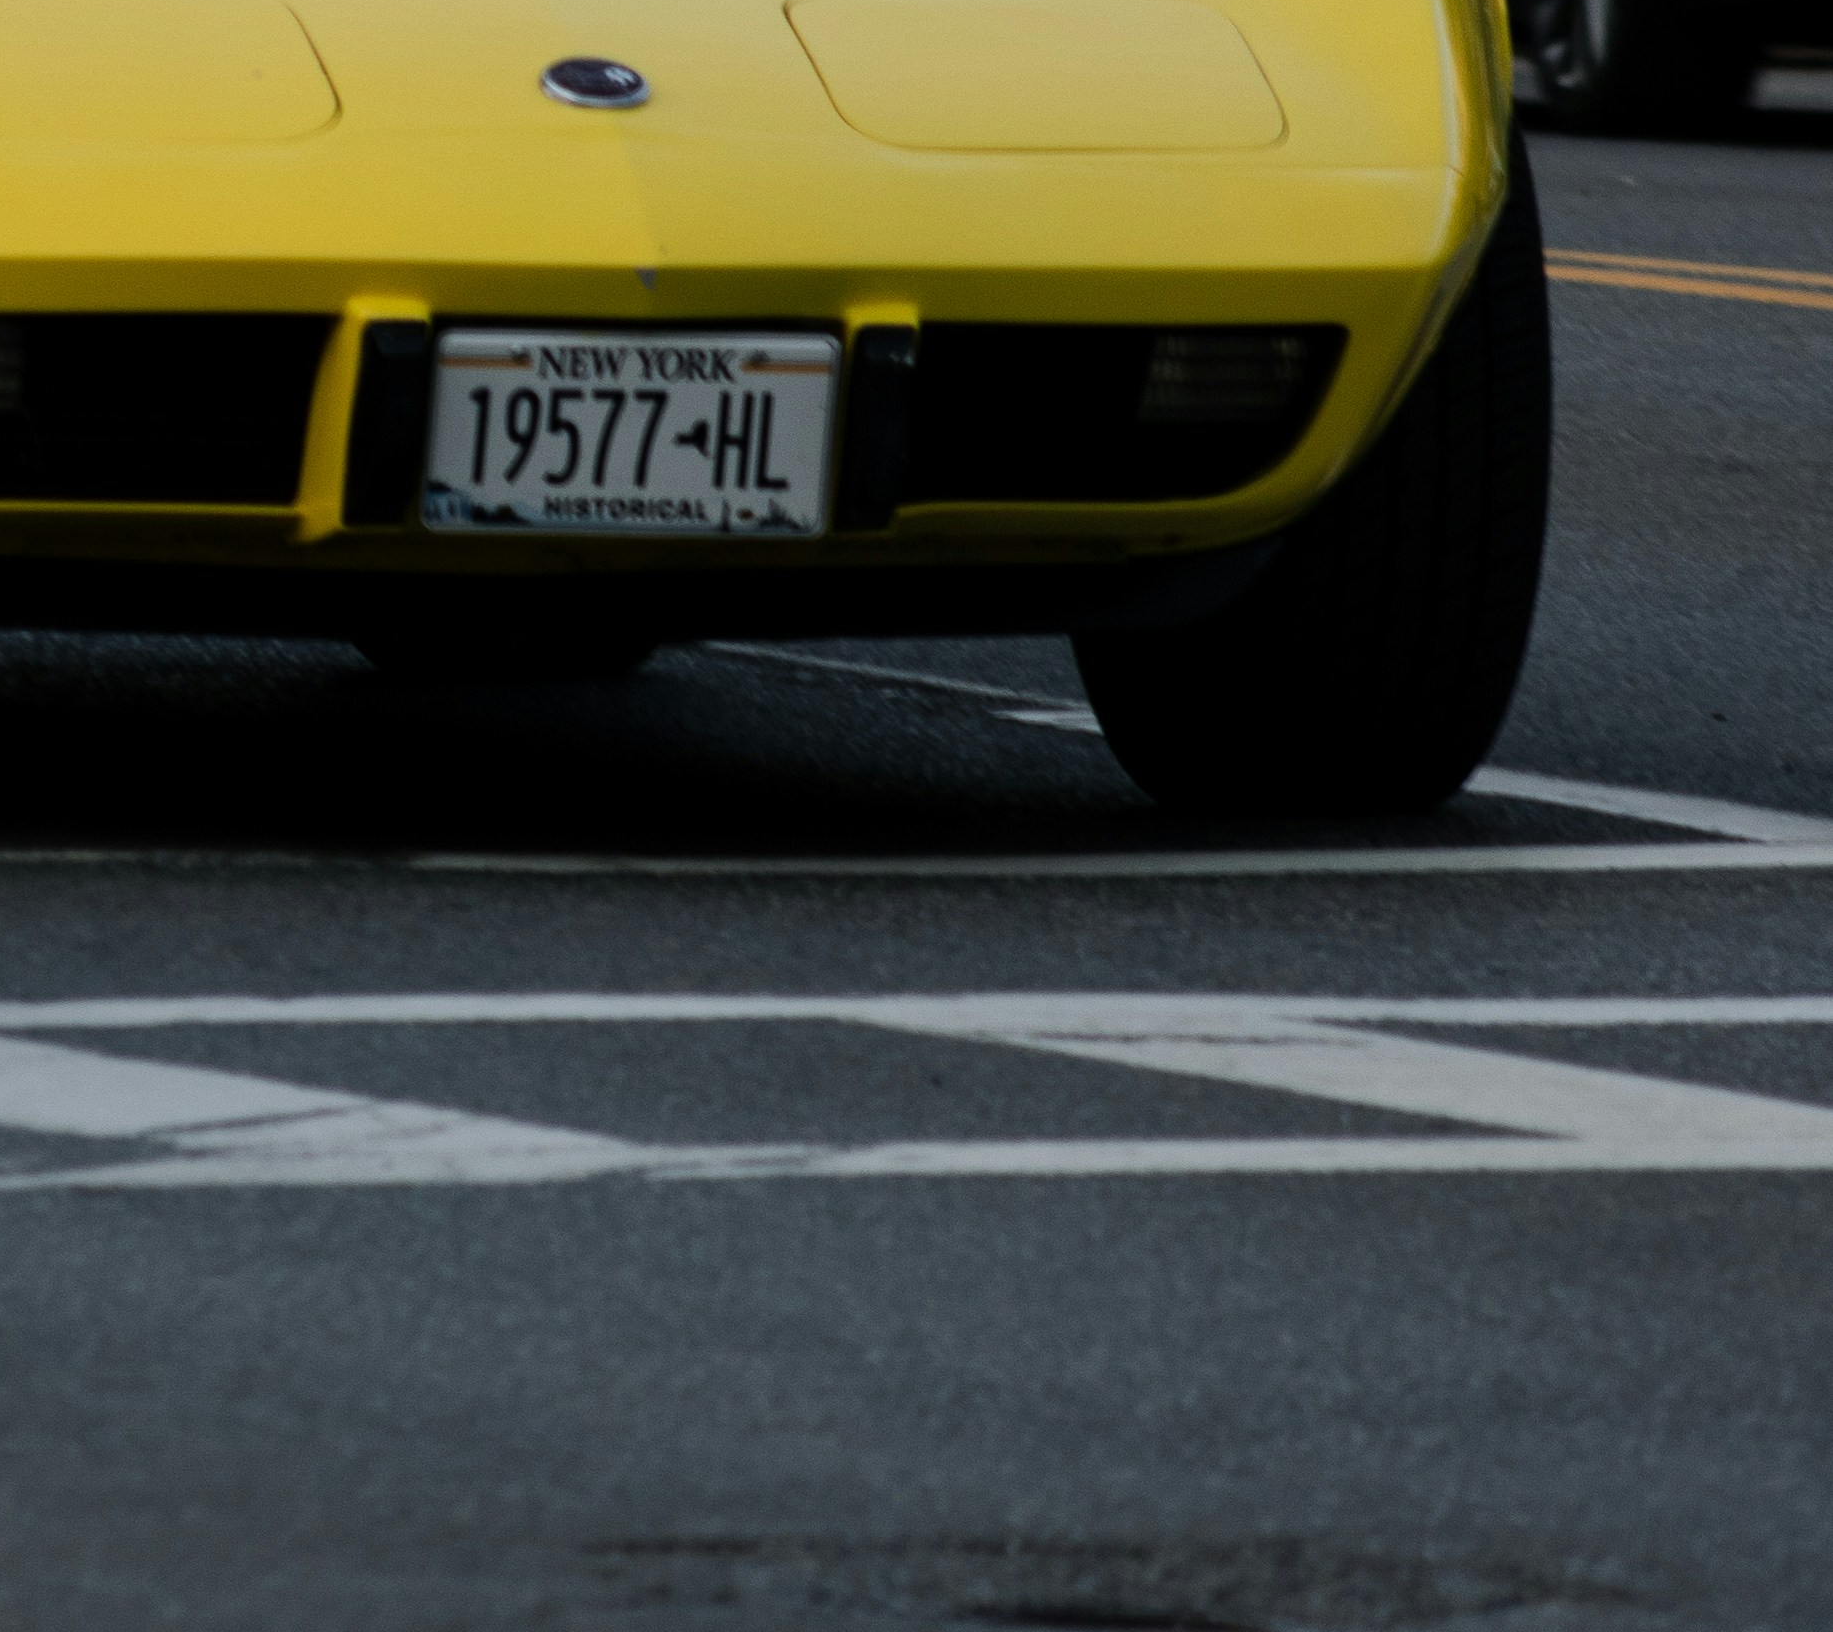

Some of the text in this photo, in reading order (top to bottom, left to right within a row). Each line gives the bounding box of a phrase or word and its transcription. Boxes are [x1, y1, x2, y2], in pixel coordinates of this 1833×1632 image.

[537, 345, 737, 382] NEW YORK
[470, 386, 790, 491] 19577 HL
[542, 495, 709, 523] HISTORICAL
